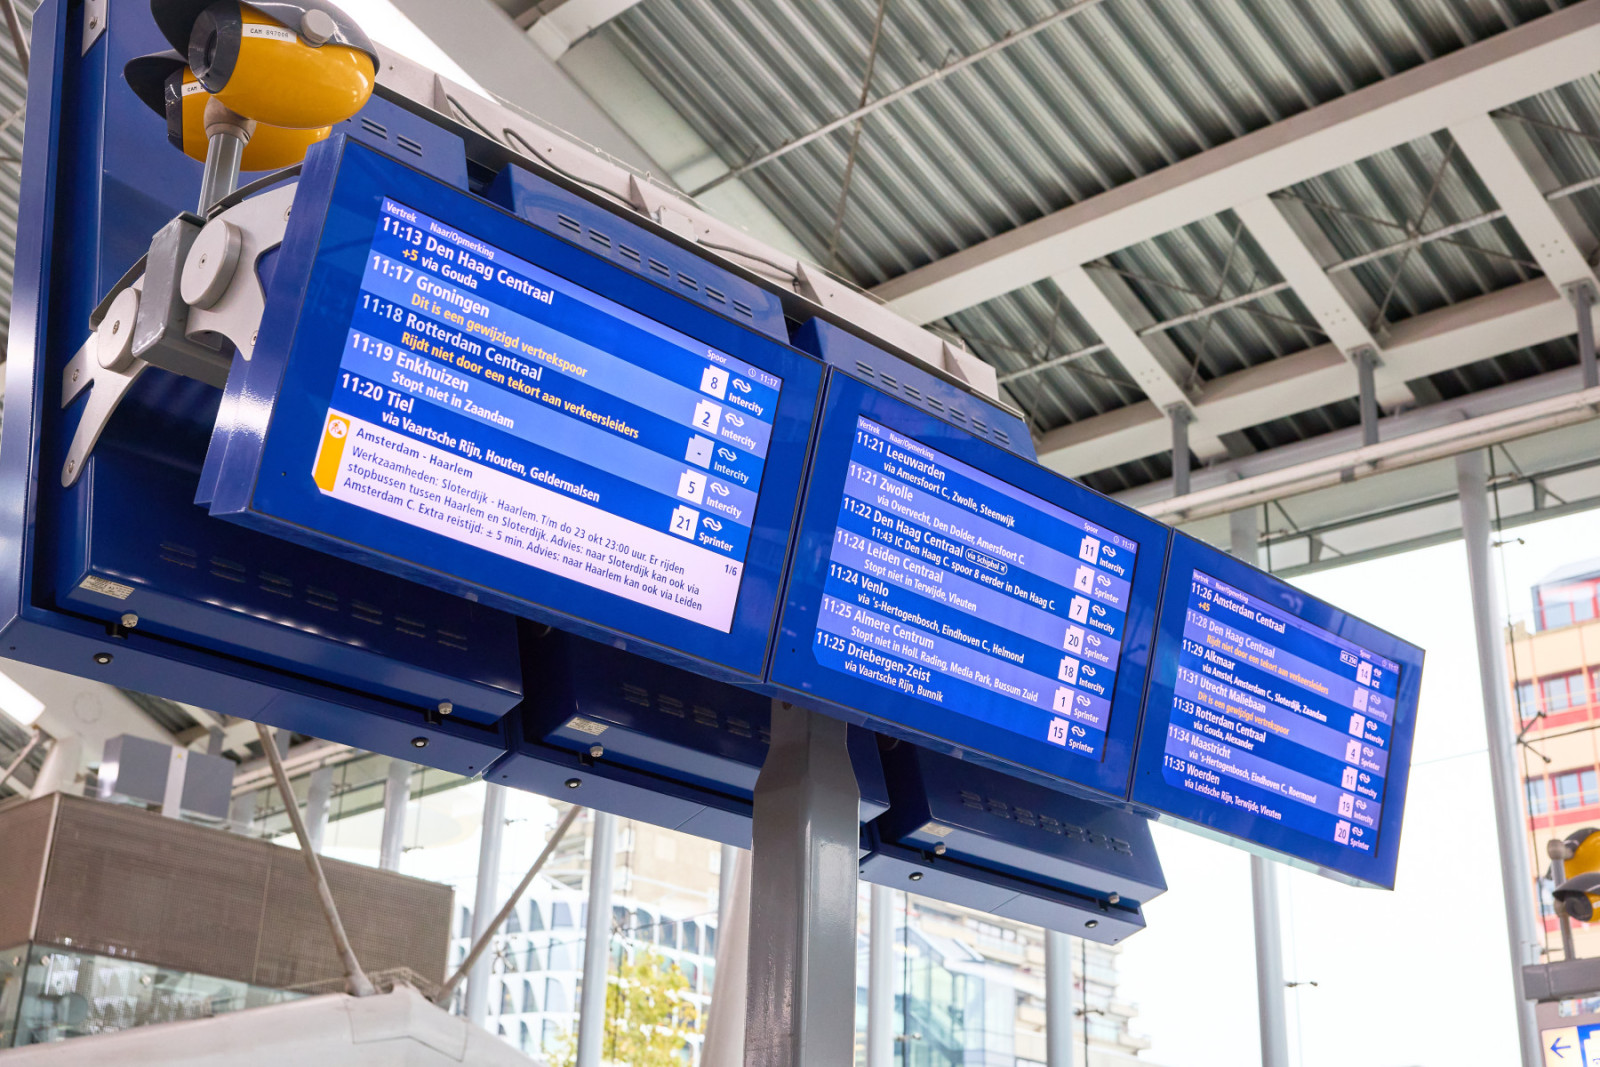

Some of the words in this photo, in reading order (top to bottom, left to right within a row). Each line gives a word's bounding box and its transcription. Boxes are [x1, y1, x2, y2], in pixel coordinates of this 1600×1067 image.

[387, 201, 416, 222] Vertrek
[383, 216, 422, 245] 11:13
[425, 236, 454, 260] Den
[457, 250, 494, 280] Haag
[497, 269, 554, 305] Centraal
[430, 222, 494, 260] Naar/Opmerking
[373, 255, 413, 283] 11:17
[416, 276, 489, 318] Groningen
[402, 249, 418, 261] +5
[422, 256, 438, 272] via
[441, 264, 477, 289] Gouda
[363, 294, 403, 322] 11:18
[406, 312, 481, 356] Rotterdam
[485, 347, 543, 381] Centraal
[411, 293, 429, 310] Dit
[431, 301, 441, 315] is
[443, 310, 464, 325] een
[466, 319, 520, 348] gewijzigd
[521, 342, 588, 377] vertrekspoor
[353, 333, 393, 361] 11:19
[396, 351, 469, 392] Enkhuizen
[707, 349, 727, 364] Spoor
[342, 373, 383, 401] 11:20
[387, 390, 414, 413] Tiel
[401, 331, 430, 352] Rijdt
[430, 346, 454, 363] niet
[456, 355, 483, 374] door
[484, 369, 505, 384] een
[507, 376, 540, 398] tekort
[541, 392, 561, 407] aan
[564, 400, 639, 438] verkeersleiders
[710, 376, 718, 389] 8
[760, 373, 778, 386] 11:17
[391, 371, 424, 393] Stopt
[425, 386, 449, 403] niet
[450, 393, 462, 408] in
[463, 399, 514, 429] Zaandam
[702, 411, 710, 427] 2
[728, 392, 763, 416] Intercity
[355, 427, 419, 459] Amsterdam
[429, 454, 473, 478] Haarlem
[382, 411, 400, 426] via
[402, 416, 456, 448] Vaartsche
[458, 438, 482, 460] Rijn,
[485, 449, 526, 476] Houten,
[530, 466, 600, 502] Geldermalsen
[721, 426, 756, 450] Intercity
[857, 431, 884, 453] 11:21
[886, 444, 945, 481] Leeuwarden
[688, 481, 695, 494] 5
[714, 461, 749, 484] Intercity
[851, 464, 877, 486] 11:21
[879, 477, 913, 502] Zwolle
[352, 445, 438, 486] Werkzaamheden:
[441, 478, 488, 504] Sloterdijk
[497, 498, 538, 522] Haarlem.
[541, 514, 557, 529] T/m
[559, 522, 572, 534] do
[574, 526, 586, 539] 23
[587, 533, 603, 545] okt
[604, 538, 630, 555] 23:00
[631, 549, 646, 561] uur.
[649, 554, 658, 565] Er
[659, 558, 684, 575] rijden
[706, 496, 742, 519] Intercity
[883, 462, 895, 474] via
[896, 467, 940, 494] Amersfoort
[941, 486, 950, 500] C.,
[951, 491, 978, 512] Zwolle,
[979, 503, 1015, 527] Steenwijk
[347, 463, 406, 490] stopbussen
[409, 483, 441, 503] tussen
[443, 495, 484, 518] Haarlem
[487, 513, 499, 523] en
[501, 516, 548, 541] Sloterdijk.
[550, 534, 583, 554] Advies:
[585, 548, 606, 561] naar
[607, 554, 649, 578] Sloterdijk
[651, 569, 667, 584] kan
[668, 578, 685, 590] ook
[687, 583, 700, 595] via
[676, 515, 690, 530] 21
[698, 532, 733, 552] Sprinter
[844, 497, 871, 519] 11:22
[873, 510, 893, 528] Den
[895, 519, 921, 542] Haag
[923, 531, 964, 557] Centraal
[343, 477, 403, 506] Amsterdam
[406, 499, 416, 511] C.
[418, 502, 444, 520] Extra
[446, 515, 484, 534] reistijd:
[496, 530, 502, 540] 5
[504, 535, 524, 549] min.
[526, 541, 560, 561] Advies:
[562, 555, 583, 568] naar
[584, 561, 622, 583] Haarlem
[623, 574, 640, 589] kan
[641, 583, 658, 595] ook
[660, 589, 672, 600] via
[674, 593, 702, 611] Leiden
[837, 530, 865, 551] 11:24
[867, 542, 900, 566] Leiden
[902, 557, 944, 583] Centraal
[965, 549, 976, 560] via
[976, 554, 1000, 570] Schiphol
[725, 564, 737, 576] 1/6
[830, 564, 858, 585] 11:24
[861, 575, 889, 597] Venlo
[824, 597, 852, 618] 11:25
[853, 610, 890, 633] Almere
[892, 624, 934, 649] Centrum
[1192, 582, 1212, 600] 11:26
[1212, 592, 1254, 620] Amsterdam
[1255, 612, 1285, 634] Centraal
[1198, 602, 1210, 612] +45
[858, 593, 870, 605] via
[872, 597, 940, 633] 's-Hertogenbosch,
[941, 624, 980, 647] Eindhoven
[981, 639, 990, 652] C.,
[992, 643, 1024, 663] Helmond
[1187, 611, 1207, 628] 11:28
[1208, 620, 1224, 636] Den
[1225, 627, 1244, 647] Haag
[1245, 637, 1275, 658] Centraal
[817, 631, 845, 652] 11:25
[847, 642, 931, 682] Driebergen-Zeist
[1064, 665, 1073, 677] 18
[1182, 639, 1203, 657] 11:29
[1203, 649, 1235, 670] Alkmaar
[844, 660, 857, 672] via
[859, 663, 896, 686] Vaartsche
[898, 678, 915, 694] Rijn,
[916, 684, 943, 702] Bunnik
[1178, 667, 1198, 685] 11:31
[1200, 677, 1228, 697] Utrecht
[1228, 688, 1266, 713] Maliebaan
[1054, 726, 1063, 738] 15
[1173, 696, 1194, 714] 11:33
[1195, 705, 1234, 730] Rotterdam
[1235, 722, 1266, 743] Centraal
[1169, 726, 1190, 743] 11:34
[1190, 734, 1231, 759] Maastricht
[1164, 755, 1185, 772] 11:35
[1187, 763, 1220, 785] Woerden
